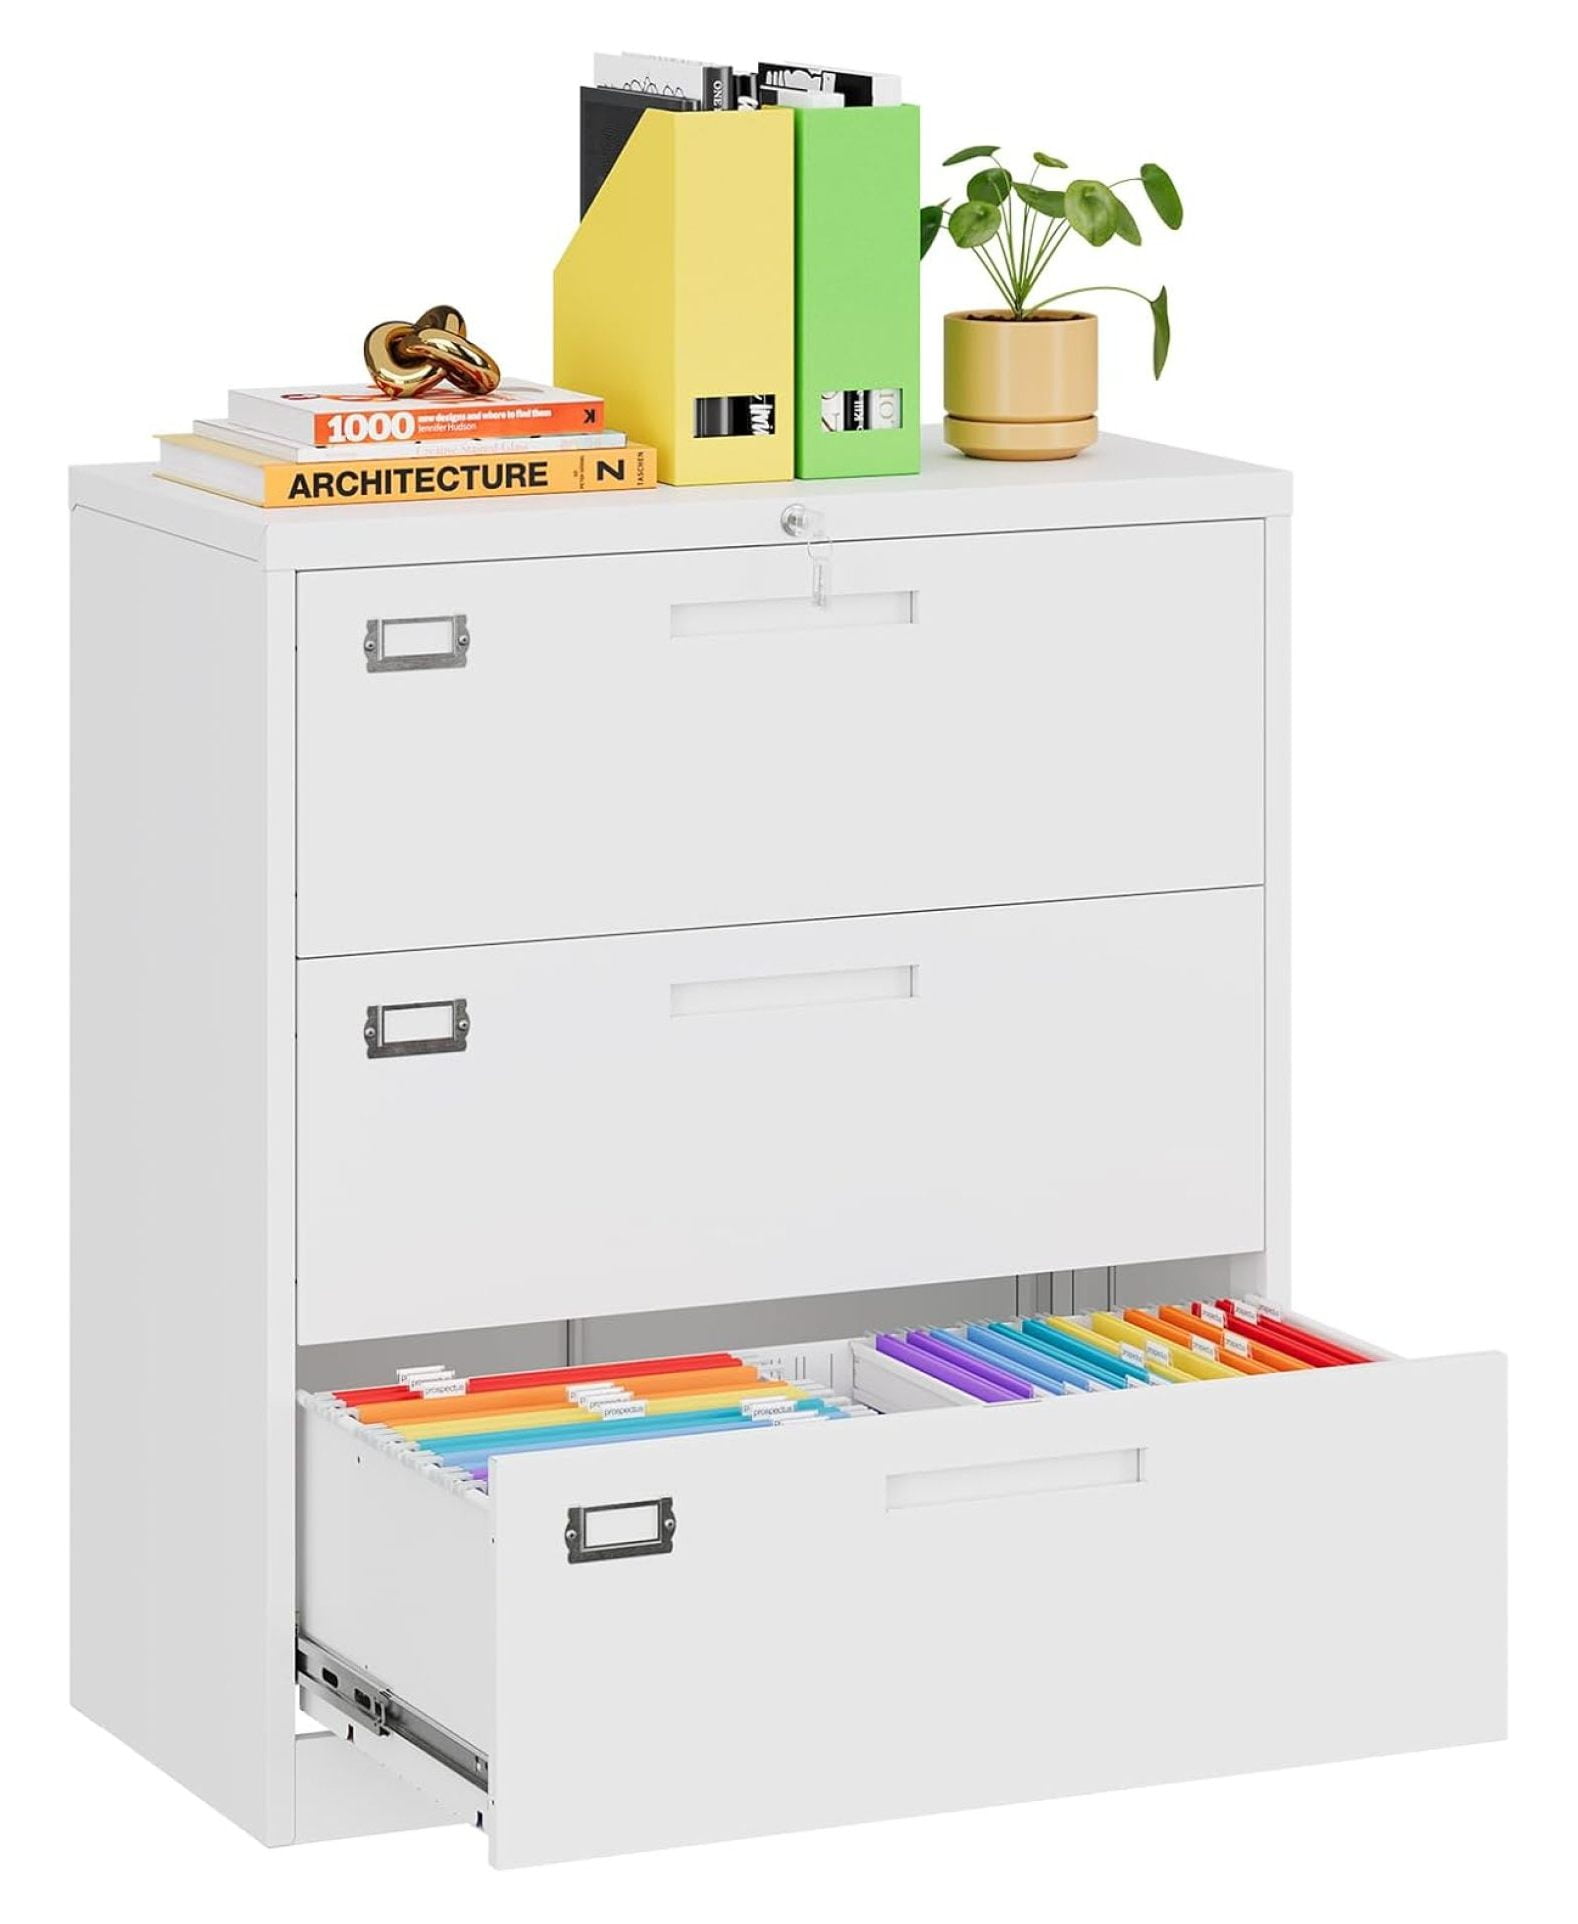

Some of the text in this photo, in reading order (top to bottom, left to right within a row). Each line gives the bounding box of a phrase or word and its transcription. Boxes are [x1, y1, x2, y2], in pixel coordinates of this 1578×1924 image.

[327, 411, 416, 443] 1000
[435, 412, 466, 424] designs
[467, 412, 482, 421] and
[482, 410, 507, 420] where
[507, 410, 515, 419] to
[516, 409, 532, 418] find
[532, 408, 552, 417] them
[448, 421, 477, 431] Hudson
[288, 461, 548, 500] ARCHITECTURE
[636, 451, 645, 486] TASCHEN
[604, 1405, 644, 1417] prospectus
